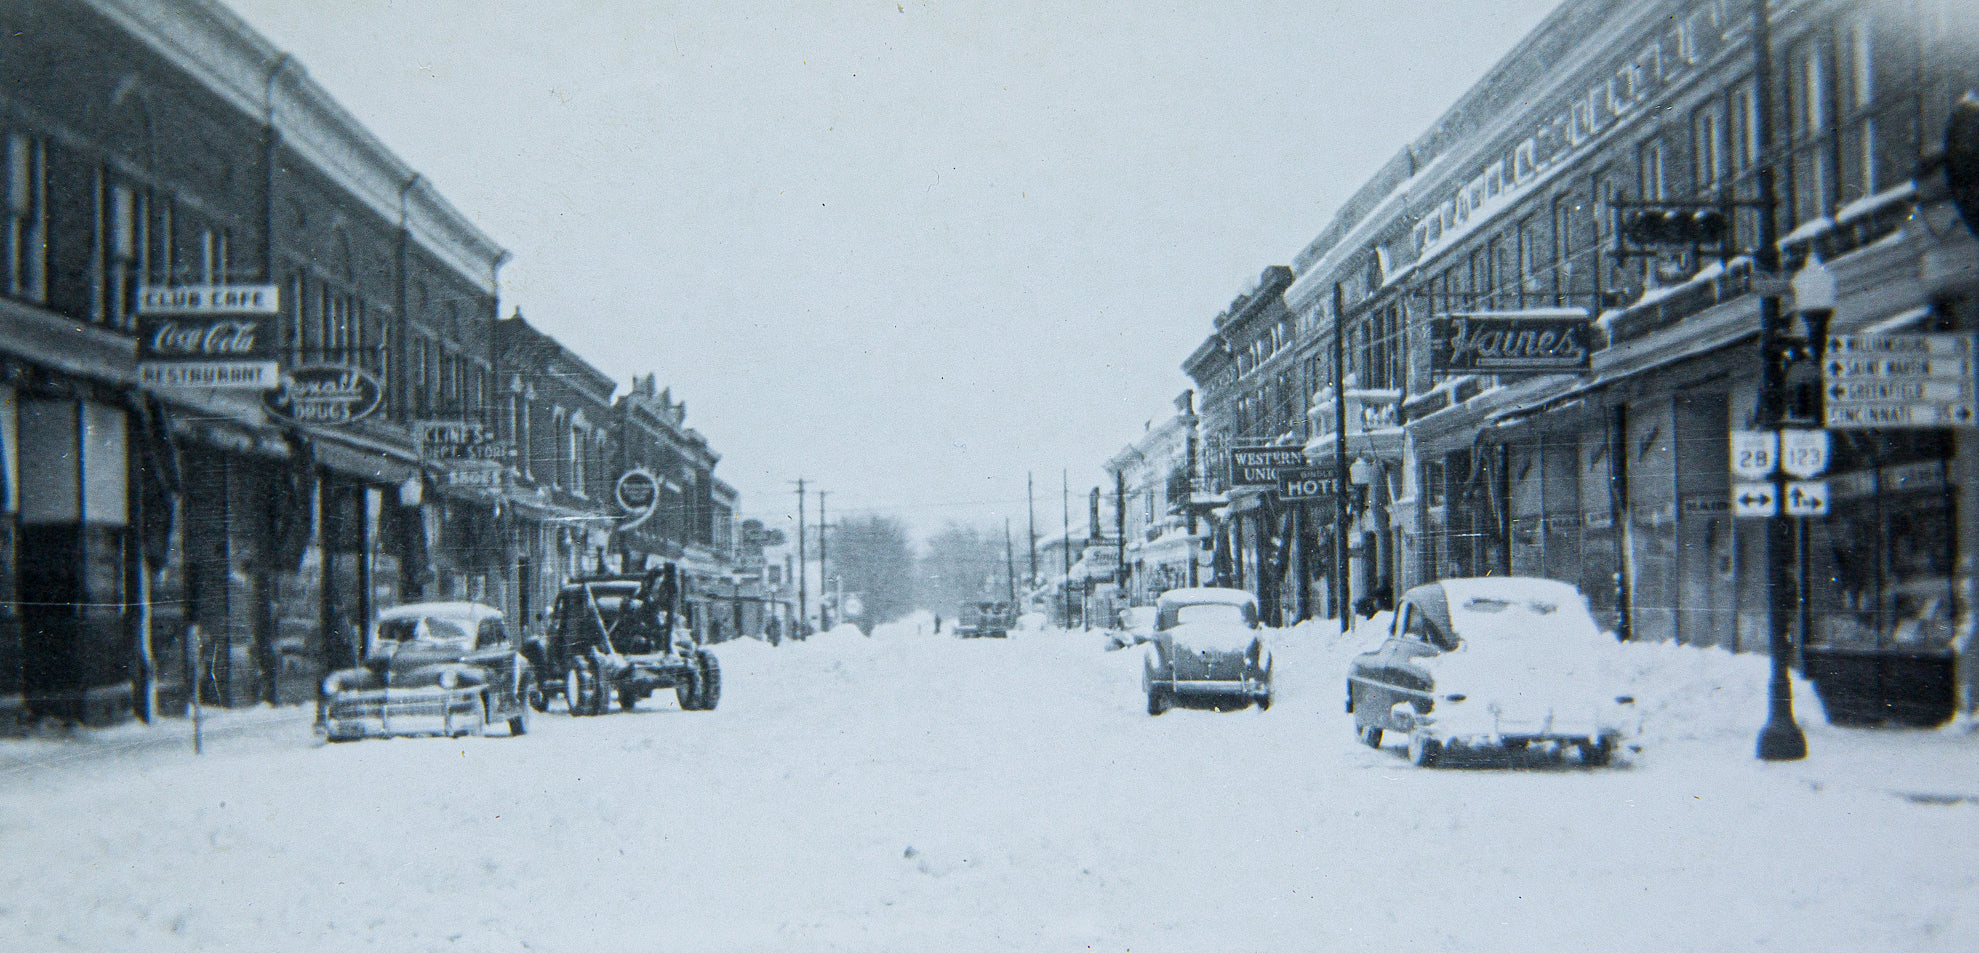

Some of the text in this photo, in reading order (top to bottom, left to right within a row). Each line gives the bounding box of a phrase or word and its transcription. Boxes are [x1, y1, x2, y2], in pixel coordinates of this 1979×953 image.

[145, 291, 264, 307] CLUB CAFE
[1450, 319, 1574, 364] Haines
[143, 367, 263, 382] RESTAURANT
[1847, 360, 1930, 376] SAINT MARTIN
[278, 370, 363, 406] Rexall
[1848, 383, 1924, 399] GREENFIELD
[294, 402, 350, 421] DRUGS
[1825, 406, 1911, 422] CINCINNATI
[466, 443, 508, 459] STORE
[1233, 451, 1302, 466] WESTERN
[1739, 449, 1768, 468] 28
[1789, 447, 1821, 467] 123
